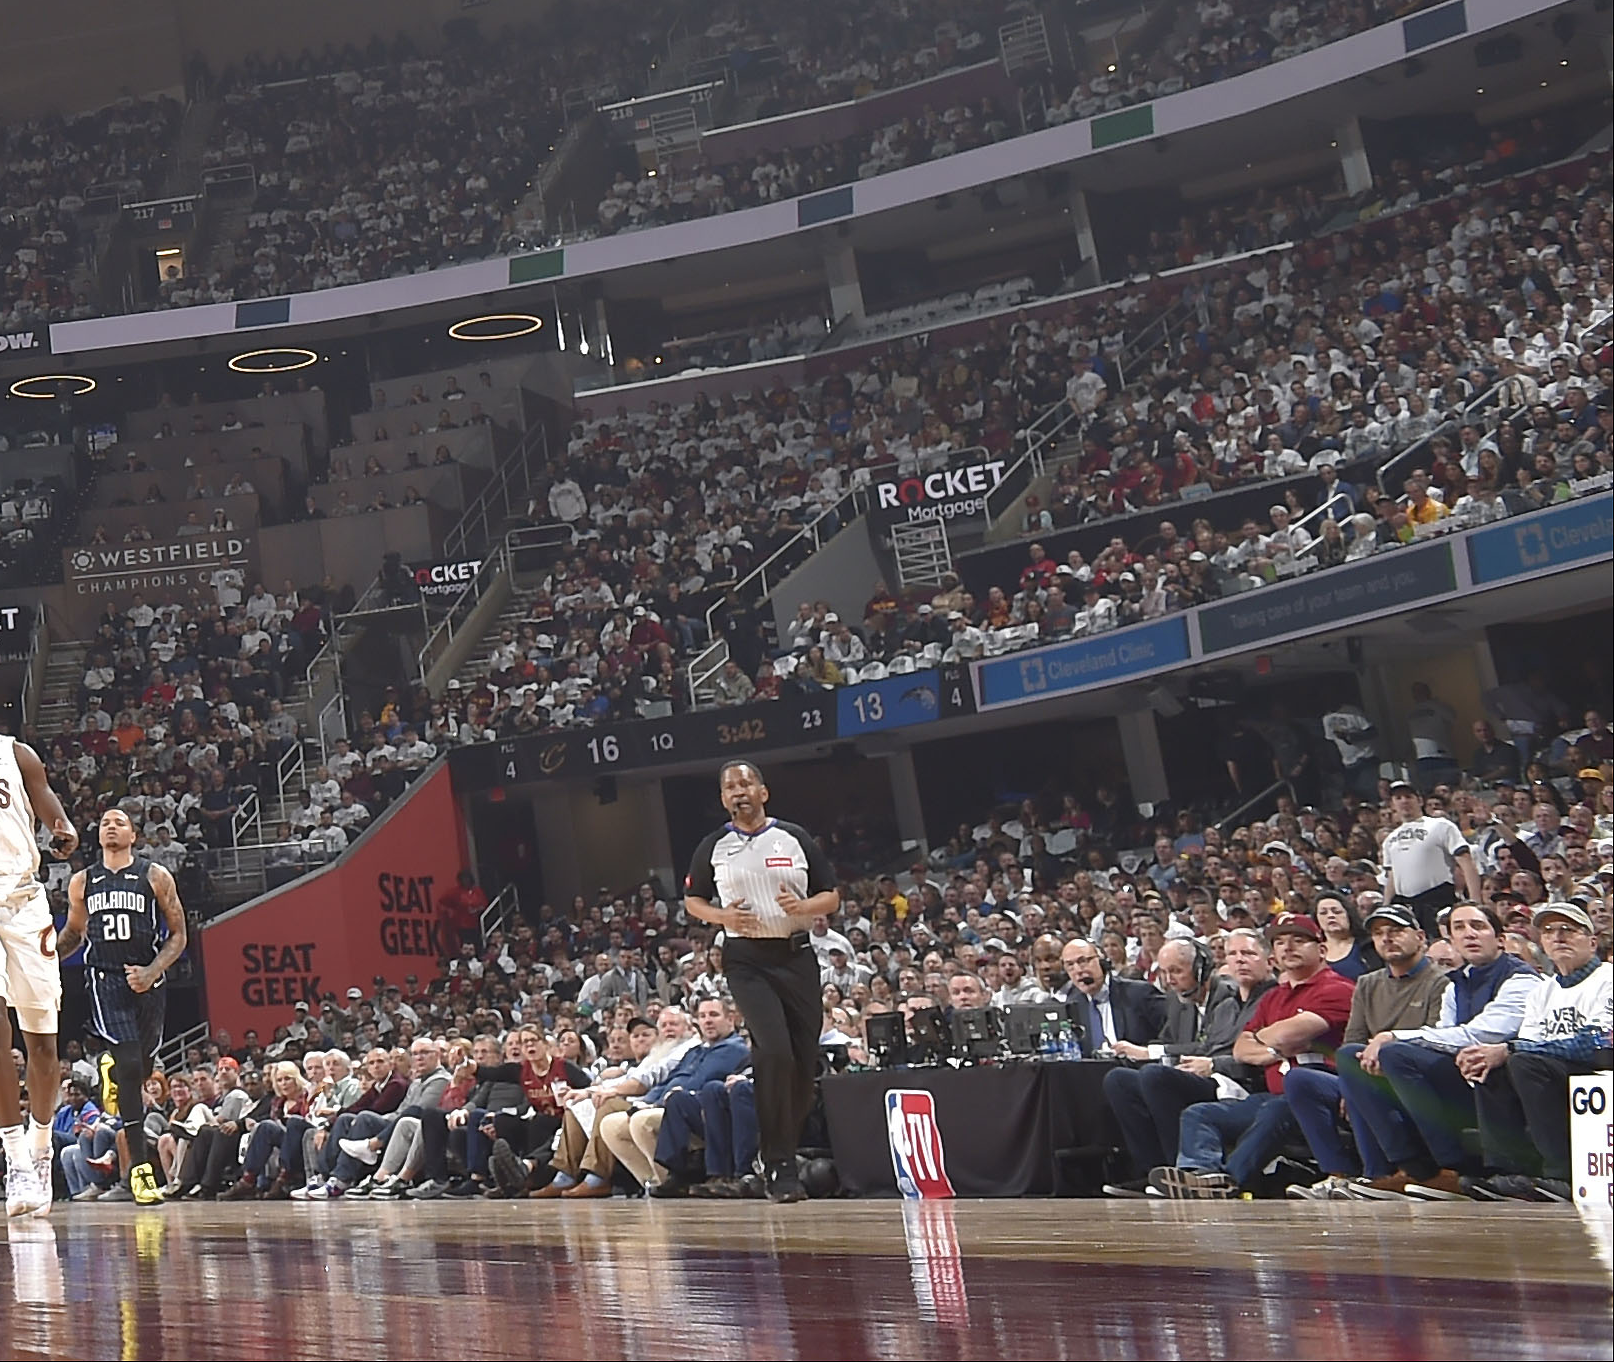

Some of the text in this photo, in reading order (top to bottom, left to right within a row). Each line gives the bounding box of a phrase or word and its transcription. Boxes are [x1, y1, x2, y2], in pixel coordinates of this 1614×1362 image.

[878, 461, 1005, 508] ROCKET
[907, 497, 985, 522] Mortgage
[99, 539, 243, 568] WESTFIELD
[77, 574, 188, 594] CHAMPIONS
[416, 560, 482, 584] OCKET
[1049, 643, 1154, 678] Cleveland Clinic
[854, 693, 883, 723] 13
[952, 688, 962, 706] 4
[588, 710, 821, 764] 16 1Q 3:42 23
[506, 762, 515, 778] 4
[88, 891, 145, 915] ORLANDO
[378, 873, 434, 914] SEAT
[102, 914, 130, 941] 20
[380, 918, 447, 958] GEEK
[242, 943, 316, 975] SEAT
[241, 976, 322, 1007] GEEK
[1573, 1087, 1606, 1115] GO
